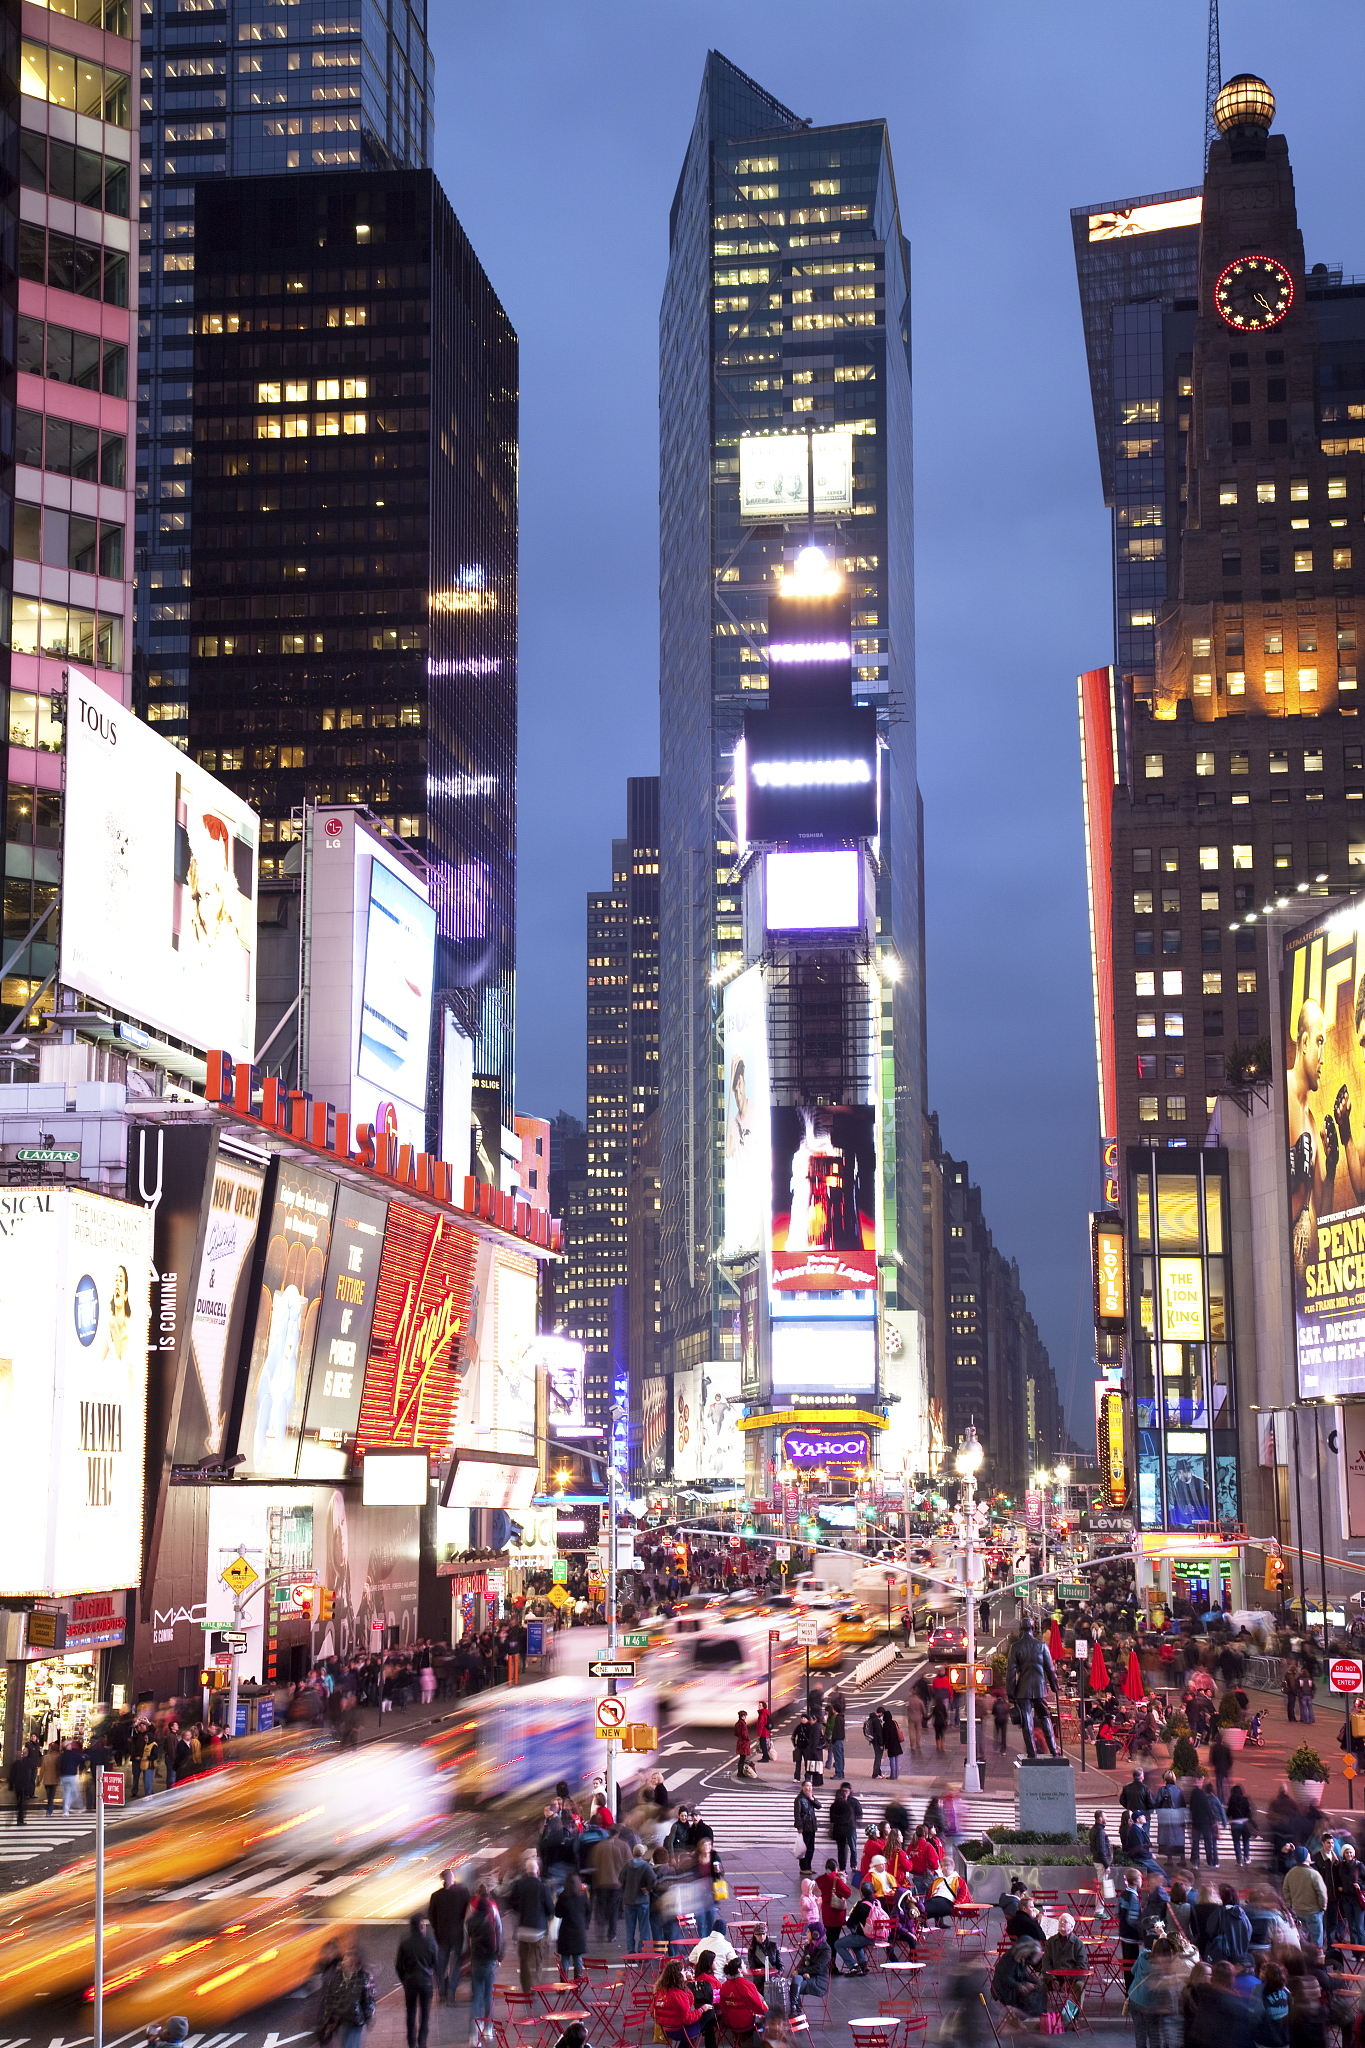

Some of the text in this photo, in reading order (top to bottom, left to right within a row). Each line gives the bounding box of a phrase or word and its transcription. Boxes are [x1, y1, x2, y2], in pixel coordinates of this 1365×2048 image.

[78, 698, 117, 746] TOUS
[752, 759, 870, 786] TOSHIBA
[326, 839, 341, 849] LG
[1286, 931, 1313, 951] ULTIMATE
[481, 1079, 500, 1090] SLICE
[23, 1151, 73, 1161] LAMAR
[0, 1194, 54, 1215] SICAL
[212, 1178, 258, 1220] NOW OPEN
[1317, 1210, 1346, 1225] LIGHTWEIGHT
[347, 1244, 364, 1273] THE
[209, 1268, 216, 1288] &
[772, 1260, 876, 1283] American Lager
[1170, 1273, 1193, 1284] THE
[335, 1274, 366, 1306] FUTURE
[1166, 1288, 1198, 1307] LION
[159, 1272, 178, 1351] IS COMING
[196, 1298, 227, 1317] DURACELL
[1304, 1304, 1315, 1314] PLUS
[1315, 1298, 1336, 1313] FRANK
[1336, 1296, 1349, 1309] MIR
[341, 1308, 353, 1335] OF
[1167, 1309, 1200, 1329] KING
[1299, 1324, 1324, 1346] SAT.
[328, 1339, 357, 1367] POWER
[1300, 1348, 1322, 1366] LIVE
[1323, 1346, 1337, 1363] ON
[323, 1370, 354, 1399] IS HERE
[790, 1394, 857, 1404] Panasonic
[786, 1440, 866, 1457] YAHOO!
[1063, 1586, 1086, 1599] Broadway
[73, 1596, 115, 1621] DIGITAL
[34, 1622, 52, 1630] COMPUTERS
[95, 1617, 127, 1632] COMPUTERS
[625, 1636, 630, 1646] W
[631, 1636, 640, 1646] 46
[602, 1728, 620, 1737] NEW
[107, 1785, 120, 1793] ANYTIME
